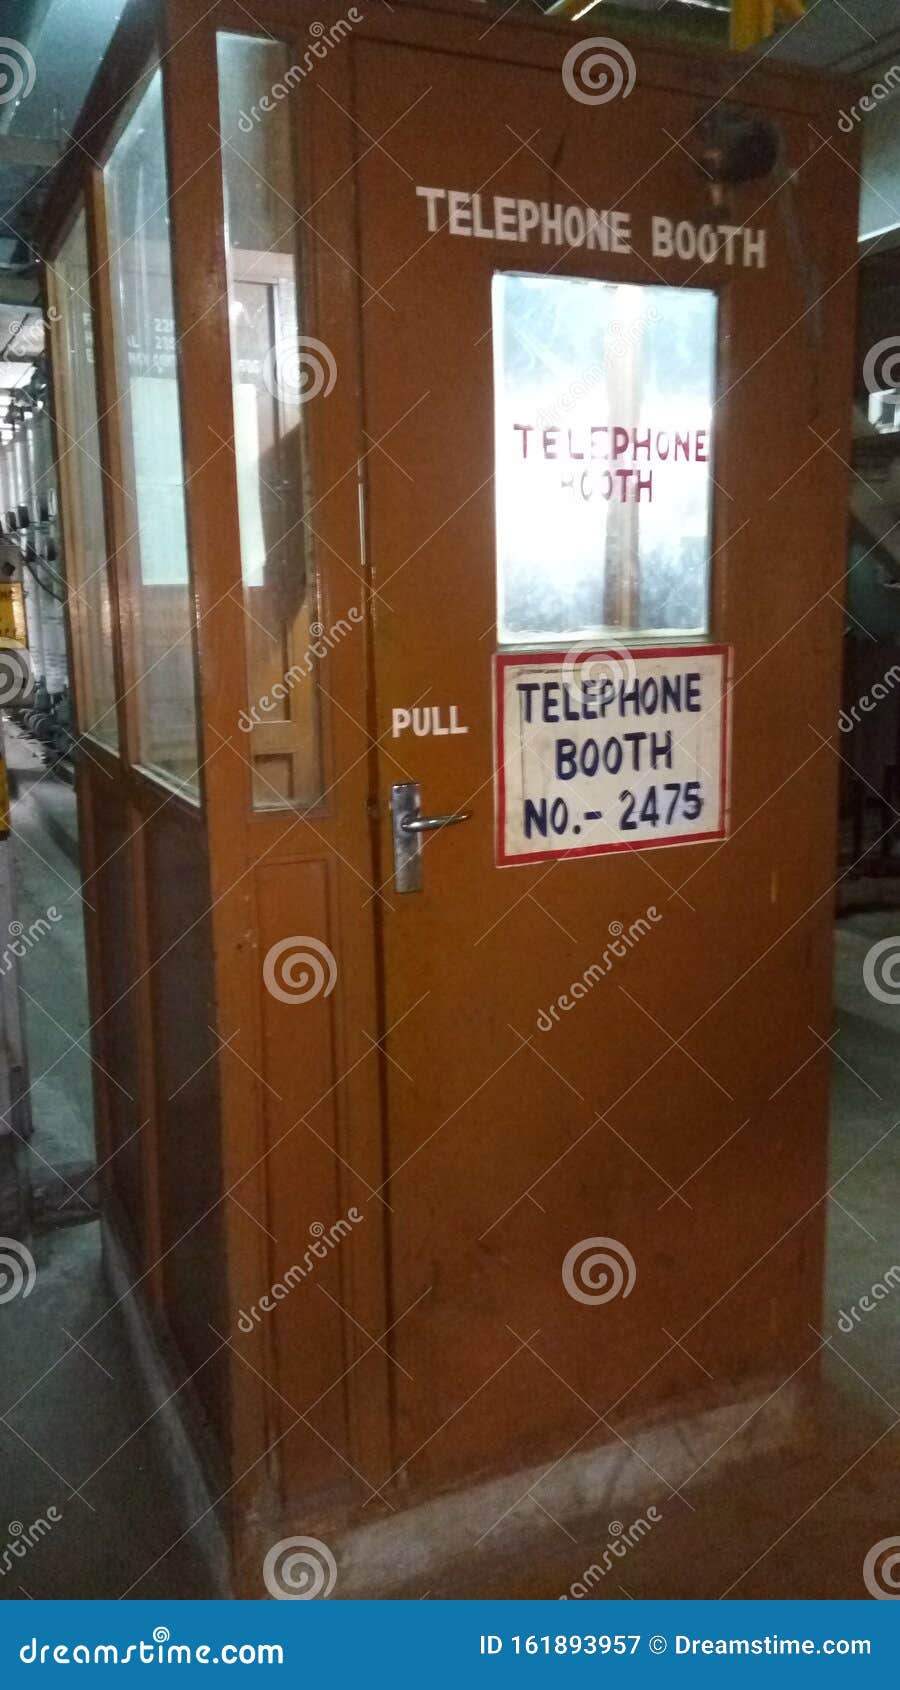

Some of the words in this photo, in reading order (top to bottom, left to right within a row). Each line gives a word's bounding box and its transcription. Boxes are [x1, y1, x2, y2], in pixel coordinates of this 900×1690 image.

[416, 186, 632, 255] TELEPHONE
[652, 216, 767, 269] BOOTH
[513, 423, 711, 463] TELEPHONE
[561, 469, 653, 503] OOTH
[392, 705, 469, 738] PULL
[516, 672, 701, 724] TELEPHONE
[555, 730, 673, 780] BOOTH
[618, 781, 702, 832] 2475
